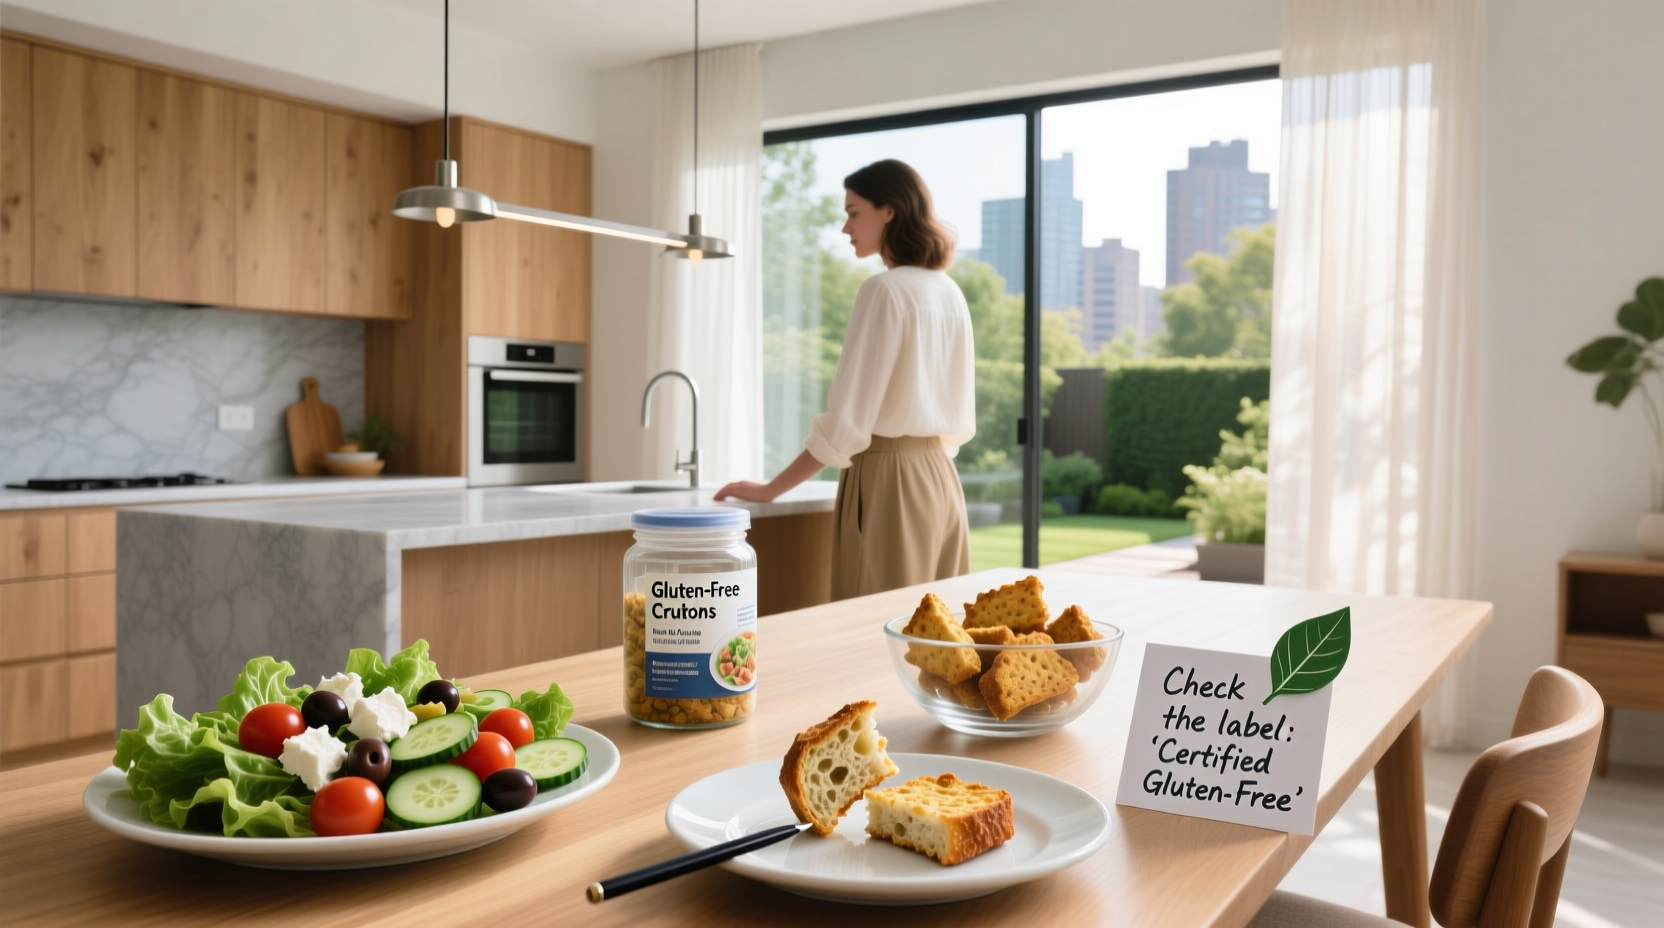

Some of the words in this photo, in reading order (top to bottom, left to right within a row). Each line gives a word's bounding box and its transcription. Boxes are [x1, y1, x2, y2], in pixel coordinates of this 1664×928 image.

[651, 581, 740, 599] Gluten-Free
[651, 602, 717, 620] Crutons
[1163, 666, 1246, 700] Check
[1162, 705, 1206, 732] the
[1218, 708, 1294, 742] label:
